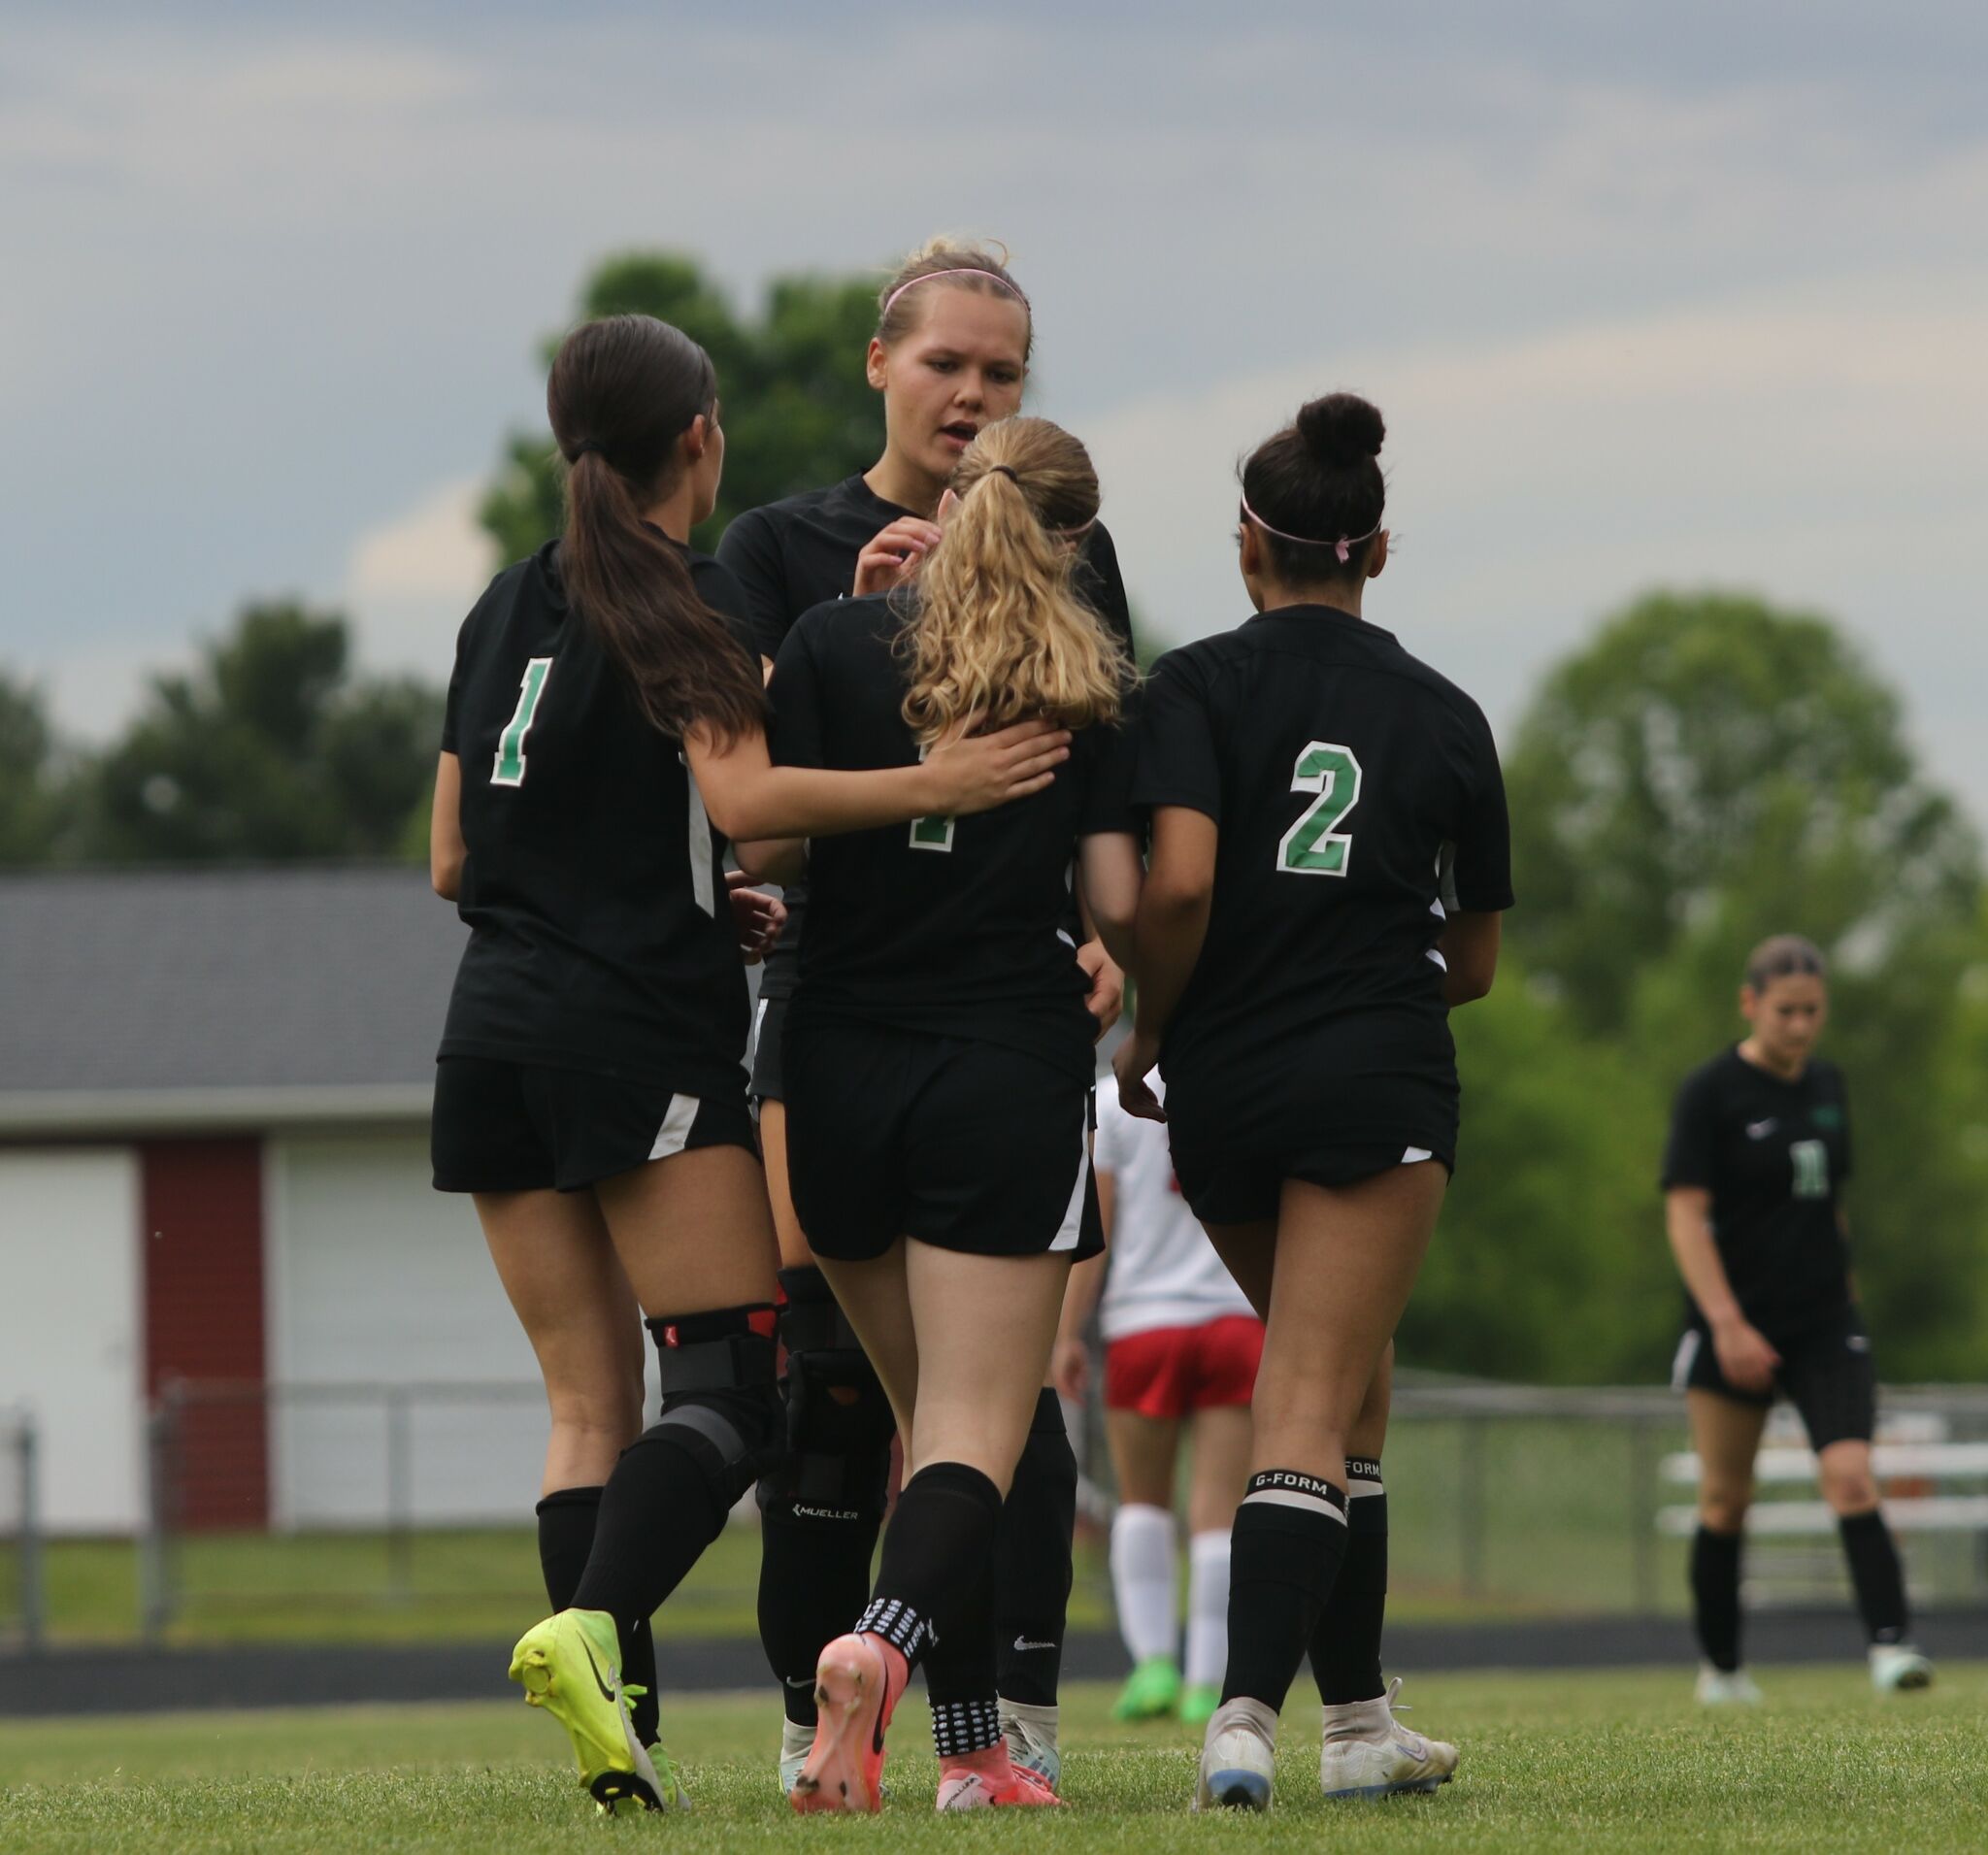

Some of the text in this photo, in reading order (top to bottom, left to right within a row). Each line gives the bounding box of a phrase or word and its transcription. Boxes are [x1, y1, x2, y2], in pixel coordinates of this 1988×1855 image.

[490, 657, 553, 787] 1
[1276, 741, 1362, 878] 2
[800, 1507, 859, 1520] MUELLER
[1255, 1473, 1328, 1496] G-FORM
